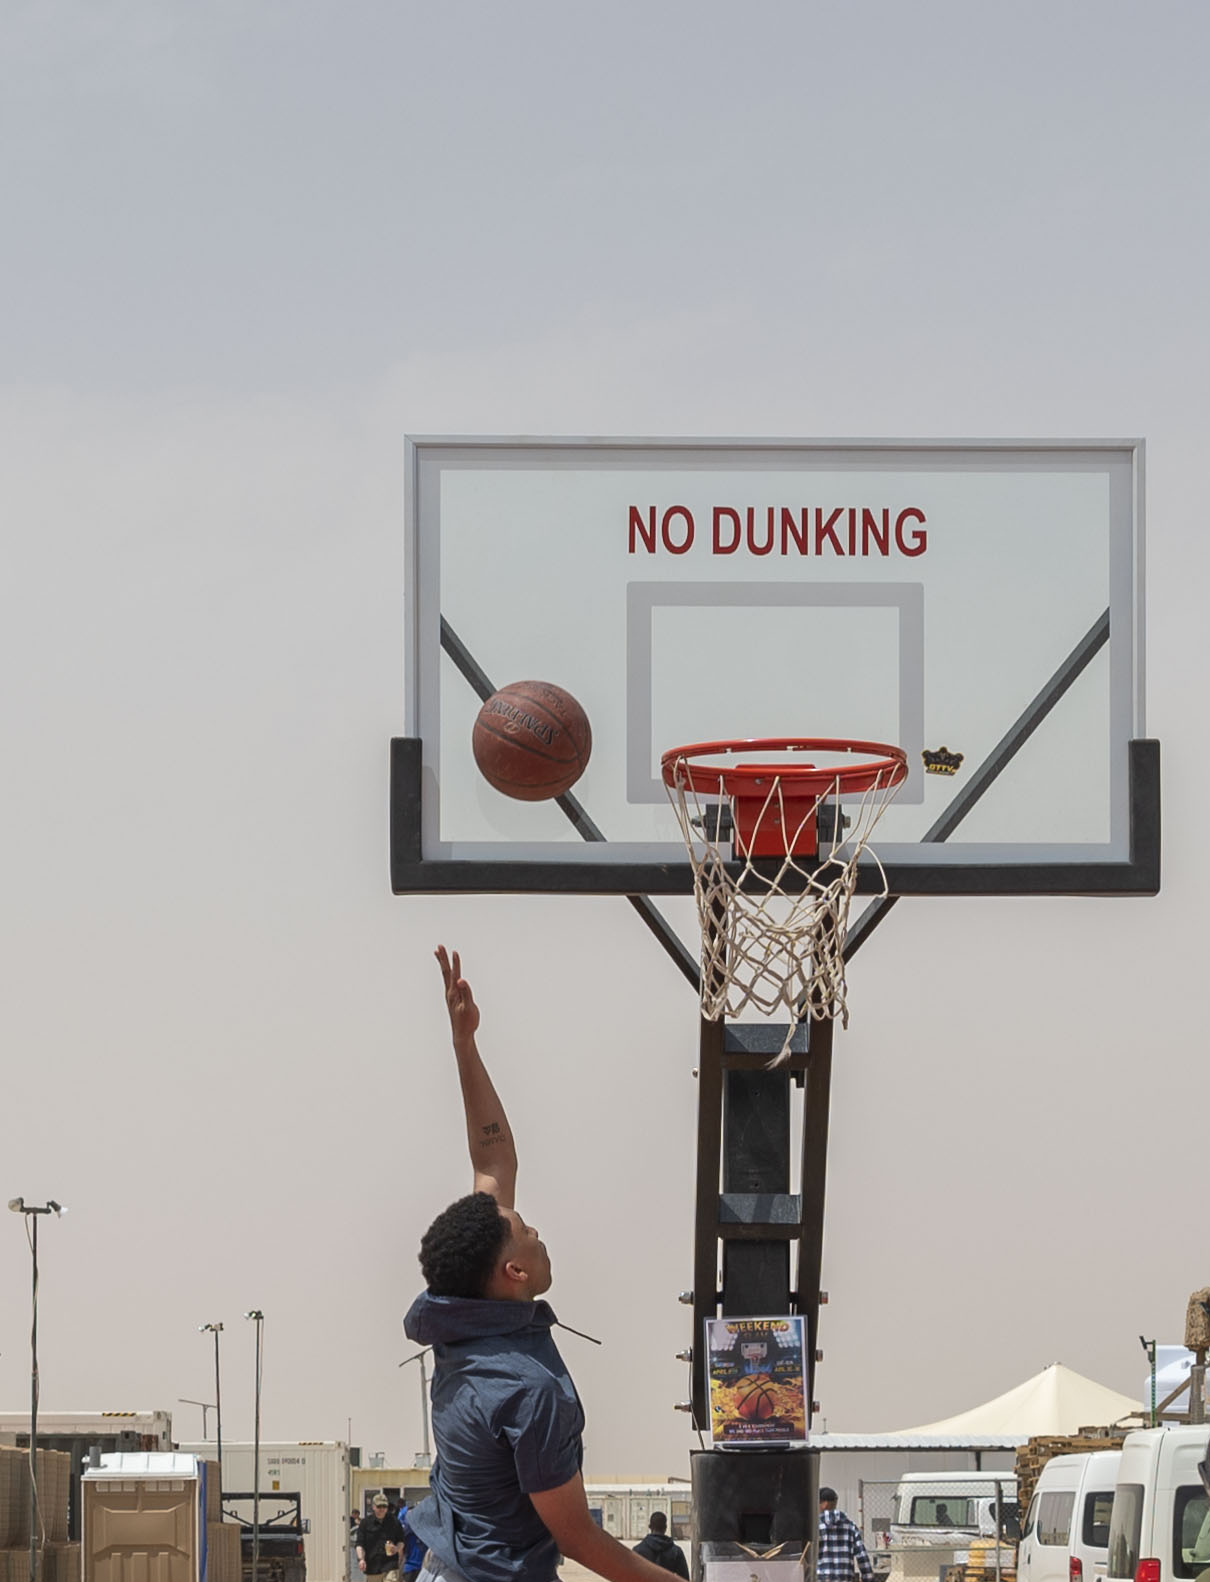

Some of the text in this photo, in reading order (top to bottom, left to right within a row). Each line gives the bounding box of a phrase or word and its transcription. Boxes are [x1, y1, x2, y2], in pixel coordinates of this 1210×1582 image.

[628, 505, 928, 557] NO DUNKING
[725, 1321, 789, 1334] WEEKEND
